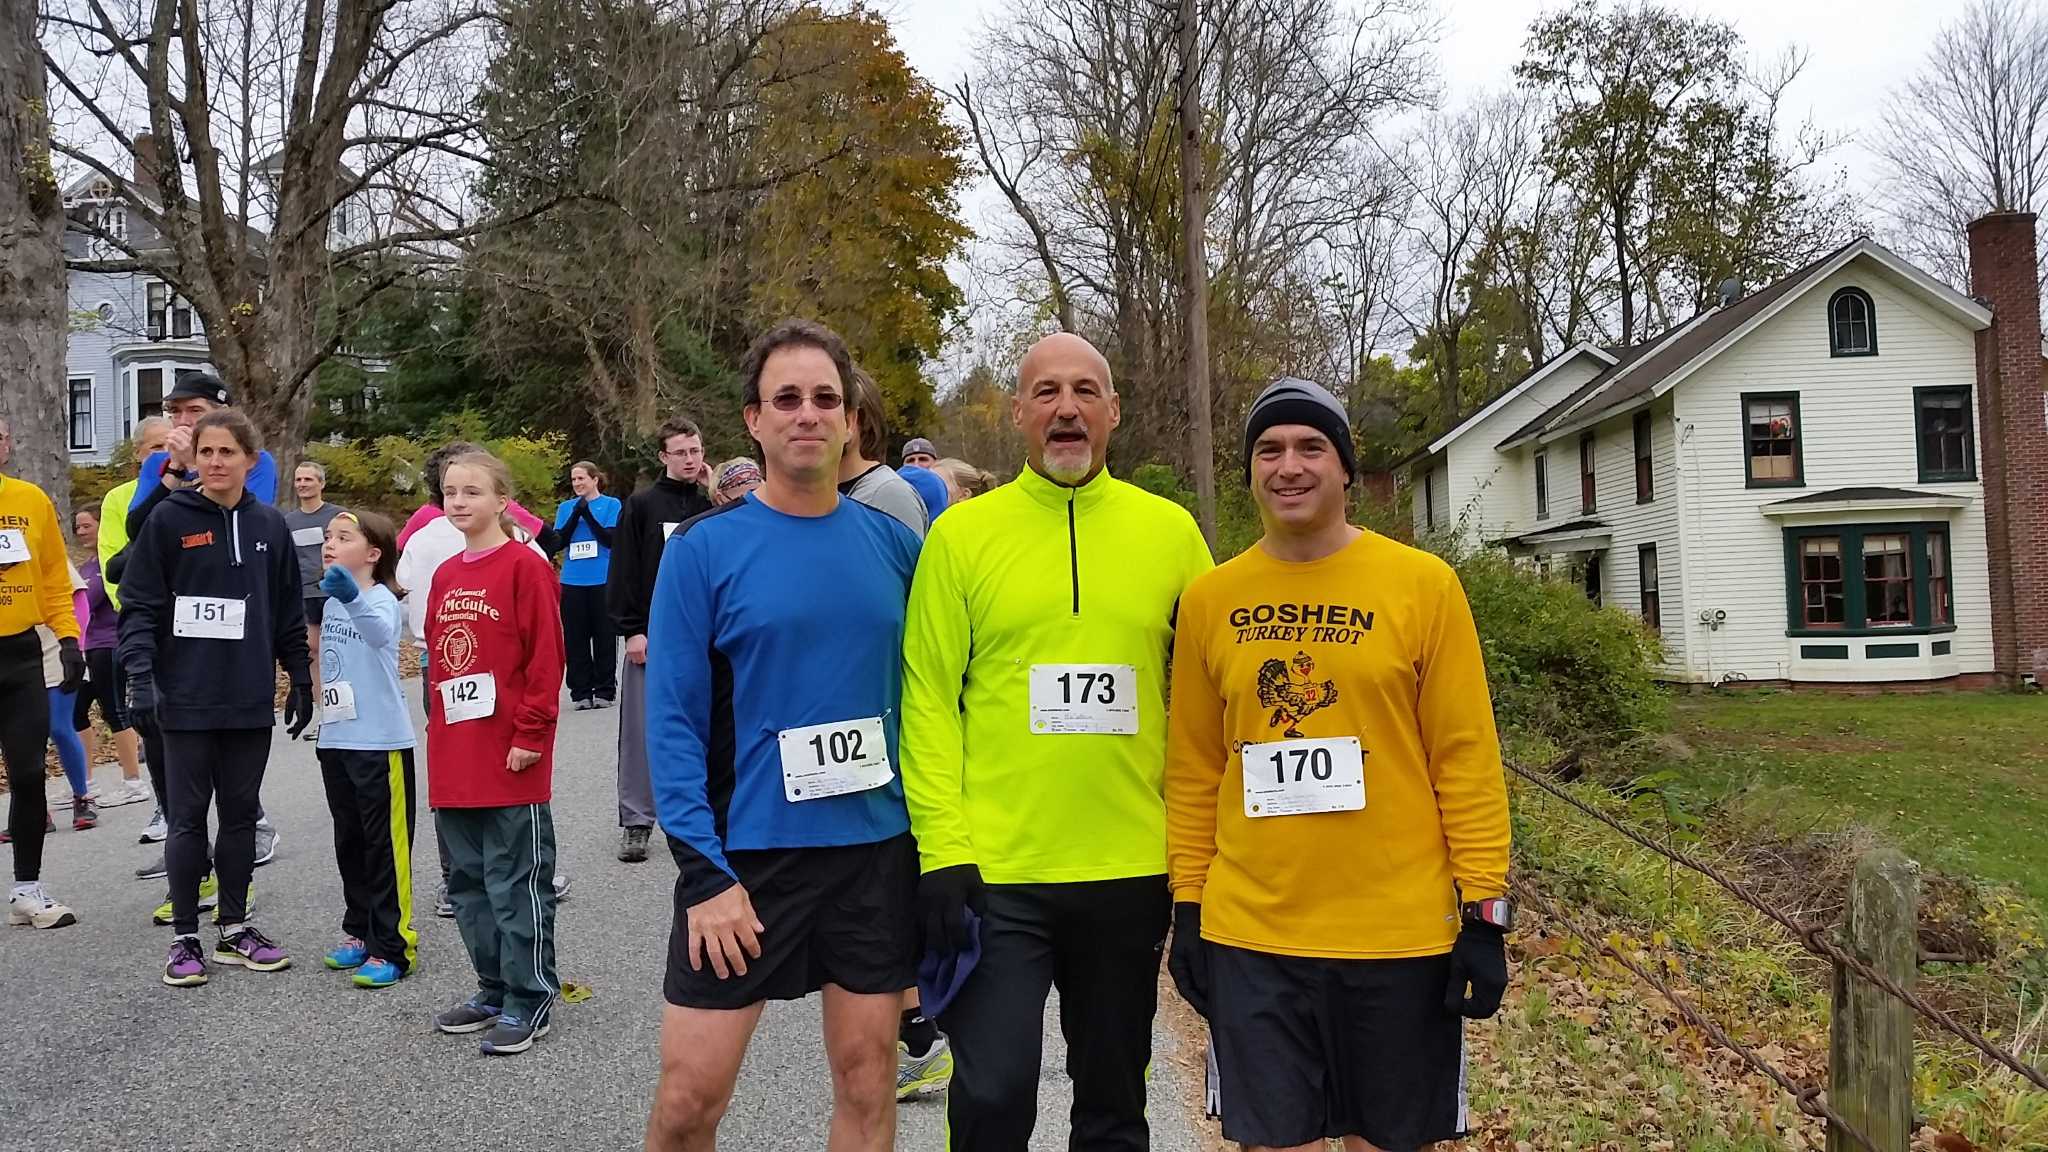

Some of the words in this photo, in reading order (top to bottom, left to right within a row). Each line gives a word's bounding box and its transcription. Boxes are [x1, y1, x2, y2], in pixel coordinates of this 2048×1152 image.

[0, 534, 11, 549] 3
[576, 543, 591, 552] 119
[192, 602, 225, 621] 151
[445, 597, 500, 621] McGuire
[1229, 603, 1375, 631] GOSHEN
[1236, 625, 1308, 644] TURKEY
[1311, 626, 1365, 645] TROT
[321, 688, 339, 707] 50
[450, 681, 478, 704] 142
[1057, 672, 1116, 704] 173
[809, 729, 867, 766] 102
[1270, 747, 1333, 784] 170
